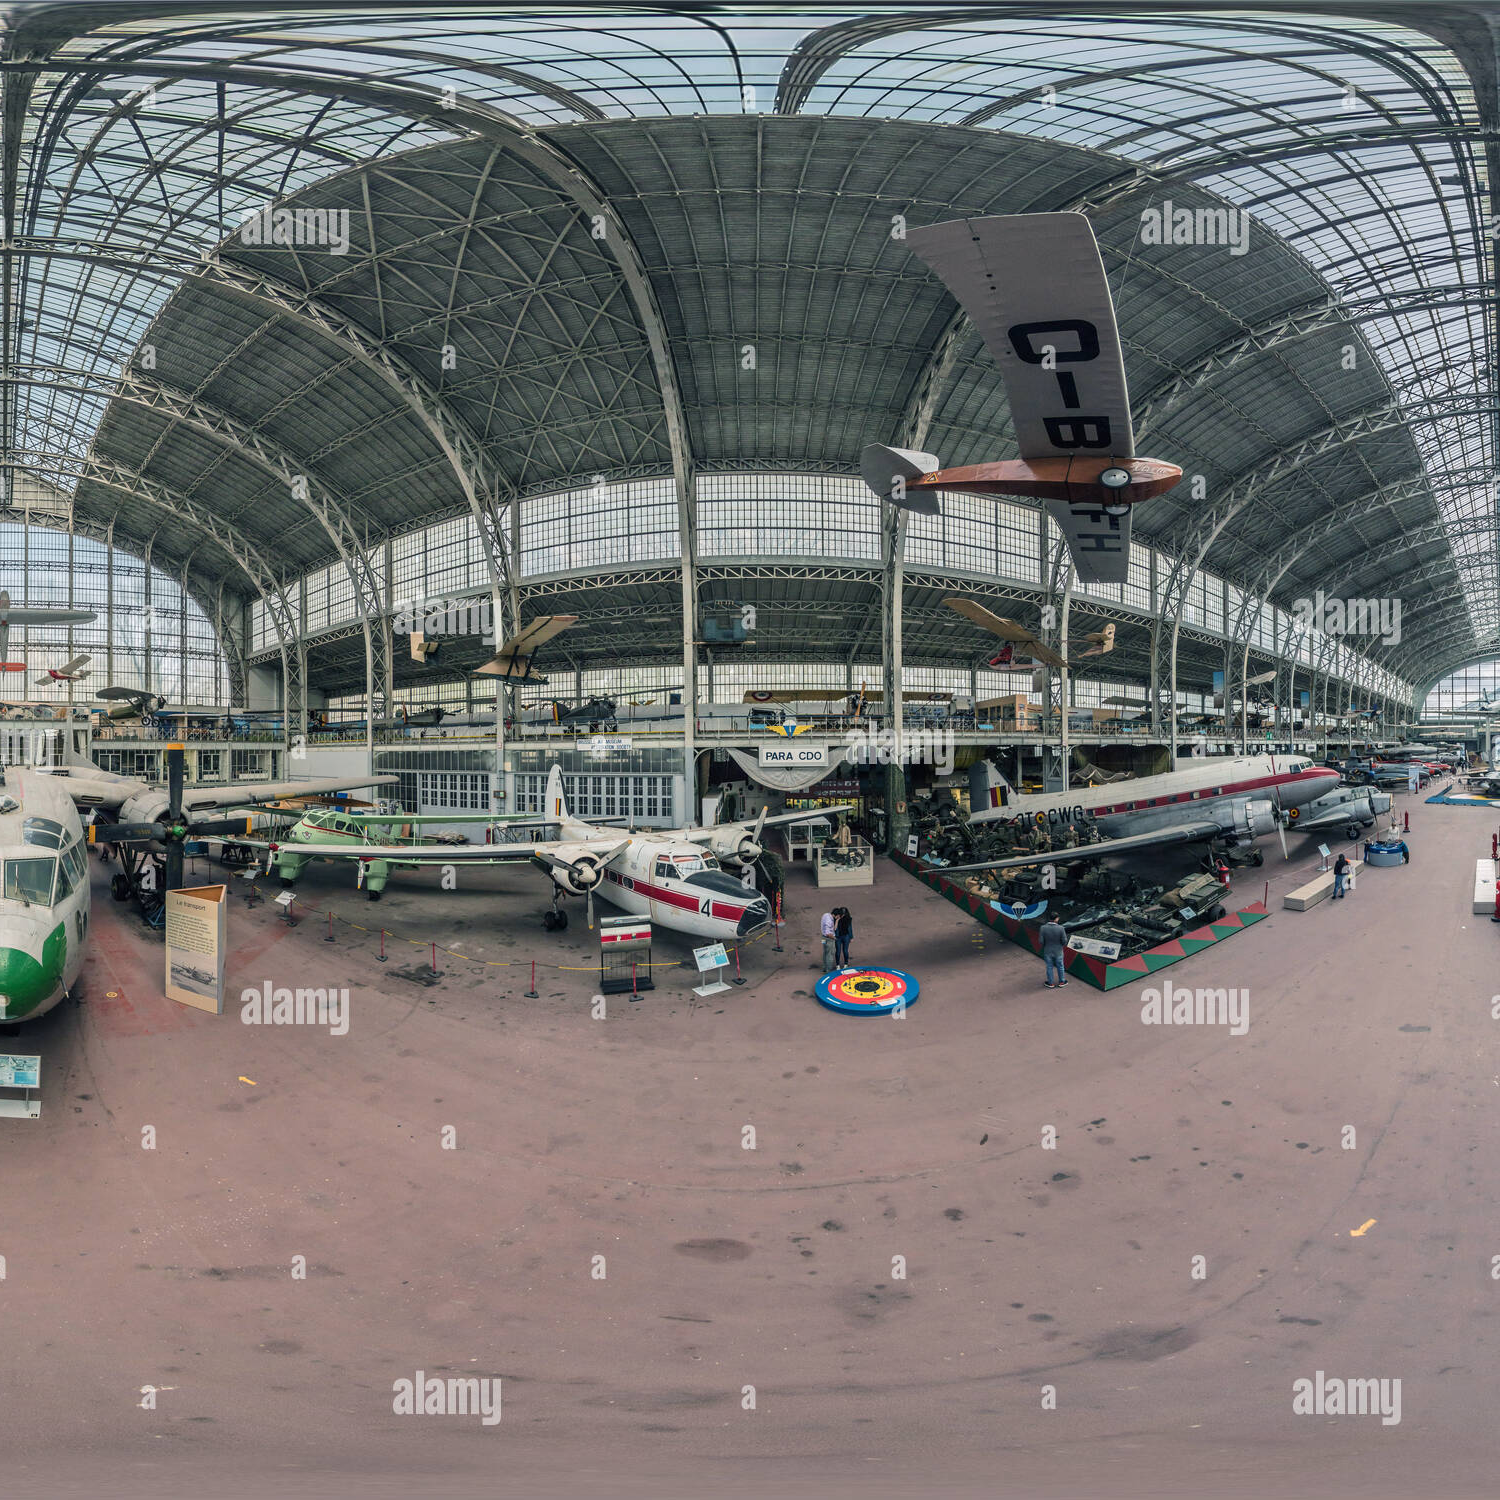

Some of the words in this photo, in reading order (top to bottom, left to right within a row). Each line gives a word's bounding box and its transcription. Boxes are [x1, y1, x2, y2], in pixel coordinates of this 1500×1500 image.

[765, 751, 793, 761] PARA
[798, 751, 822, 761] CDO
[1048, 805, 1084, 824] CWG
[184, 900, 206, 911] transport
[701, 899, 710, 917] 4
